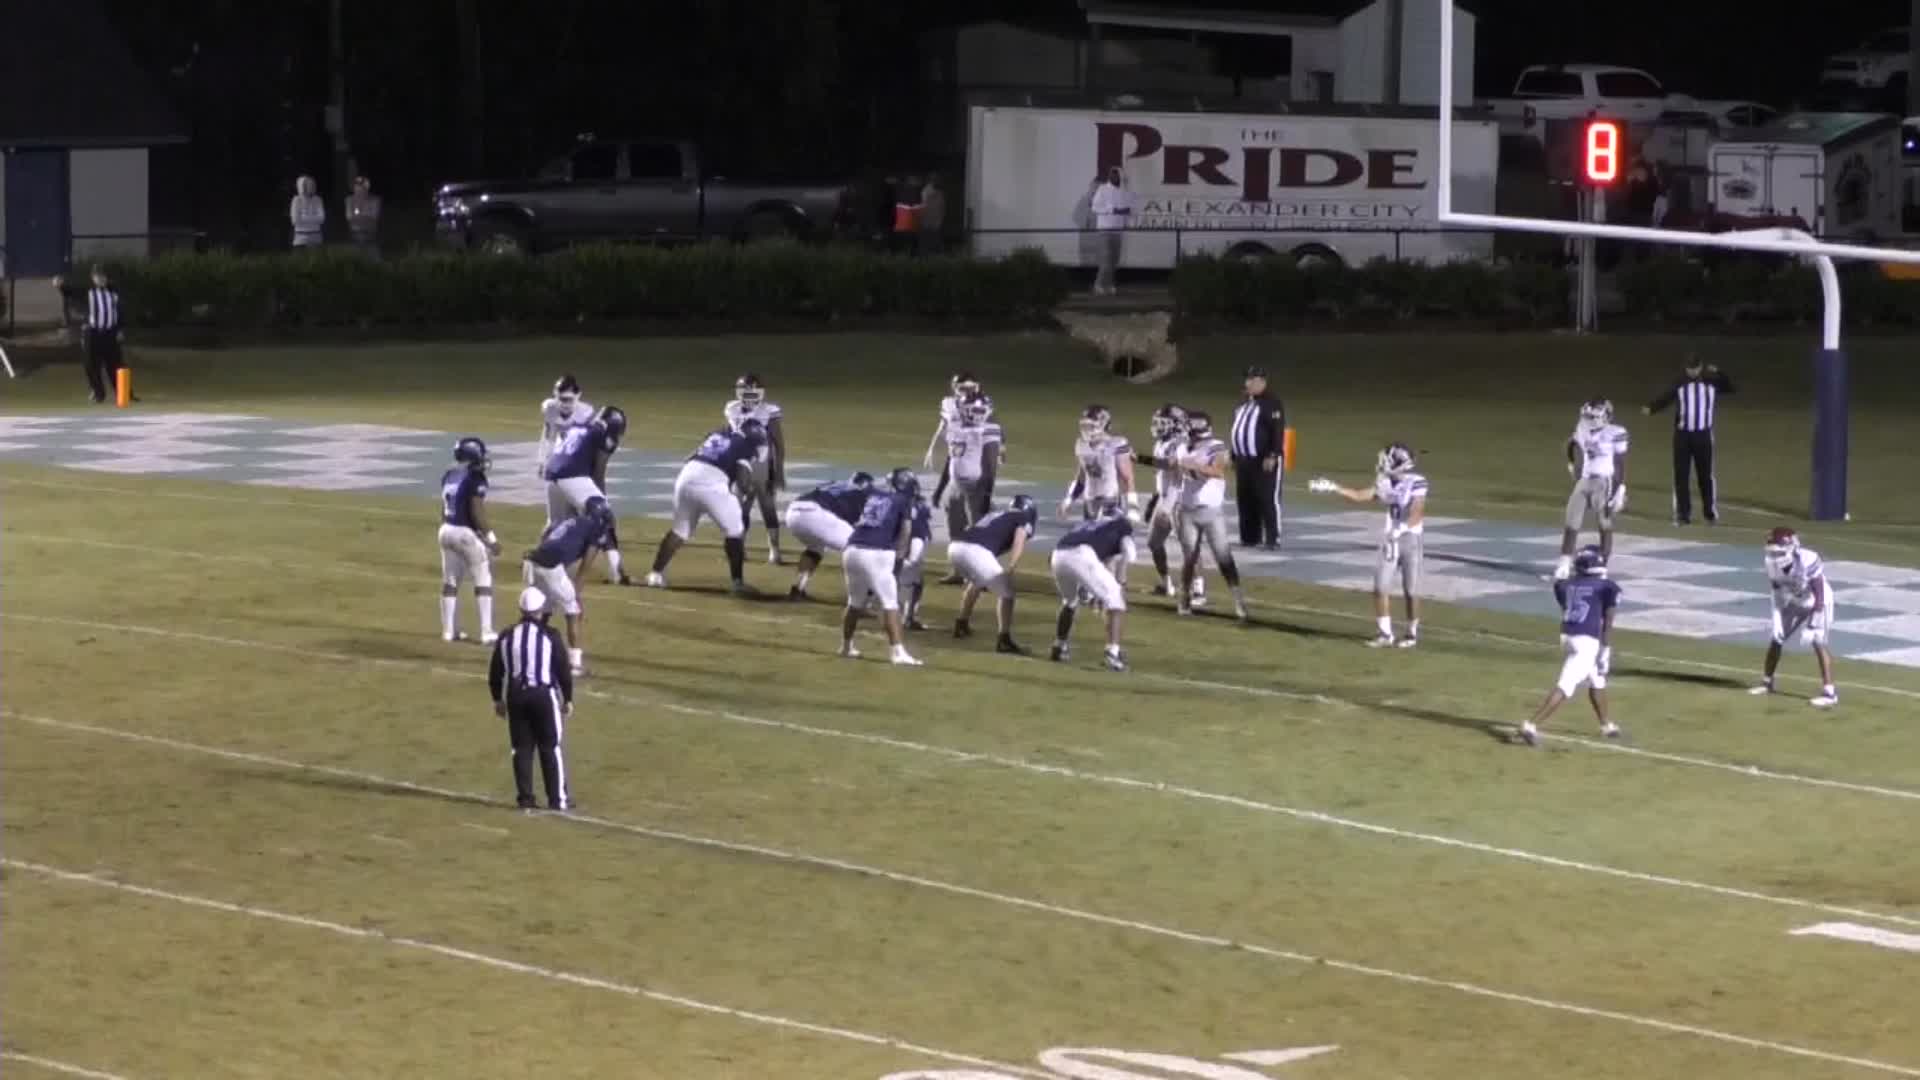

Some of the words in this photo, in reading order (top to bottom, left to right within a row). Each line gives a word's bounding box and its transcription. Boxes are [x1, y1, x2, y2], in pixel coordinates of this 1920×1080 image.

[1238, 127, 1284, 141] THE
[1588, 122, 1617, 180] 8
[1095, 122, 1427, 200] PRIDE
[1143, 200, 1339, 217] ALEXANDER
[1349, 202, 1422, 217] CITY
[1564, 584, 1594, 623] 15
